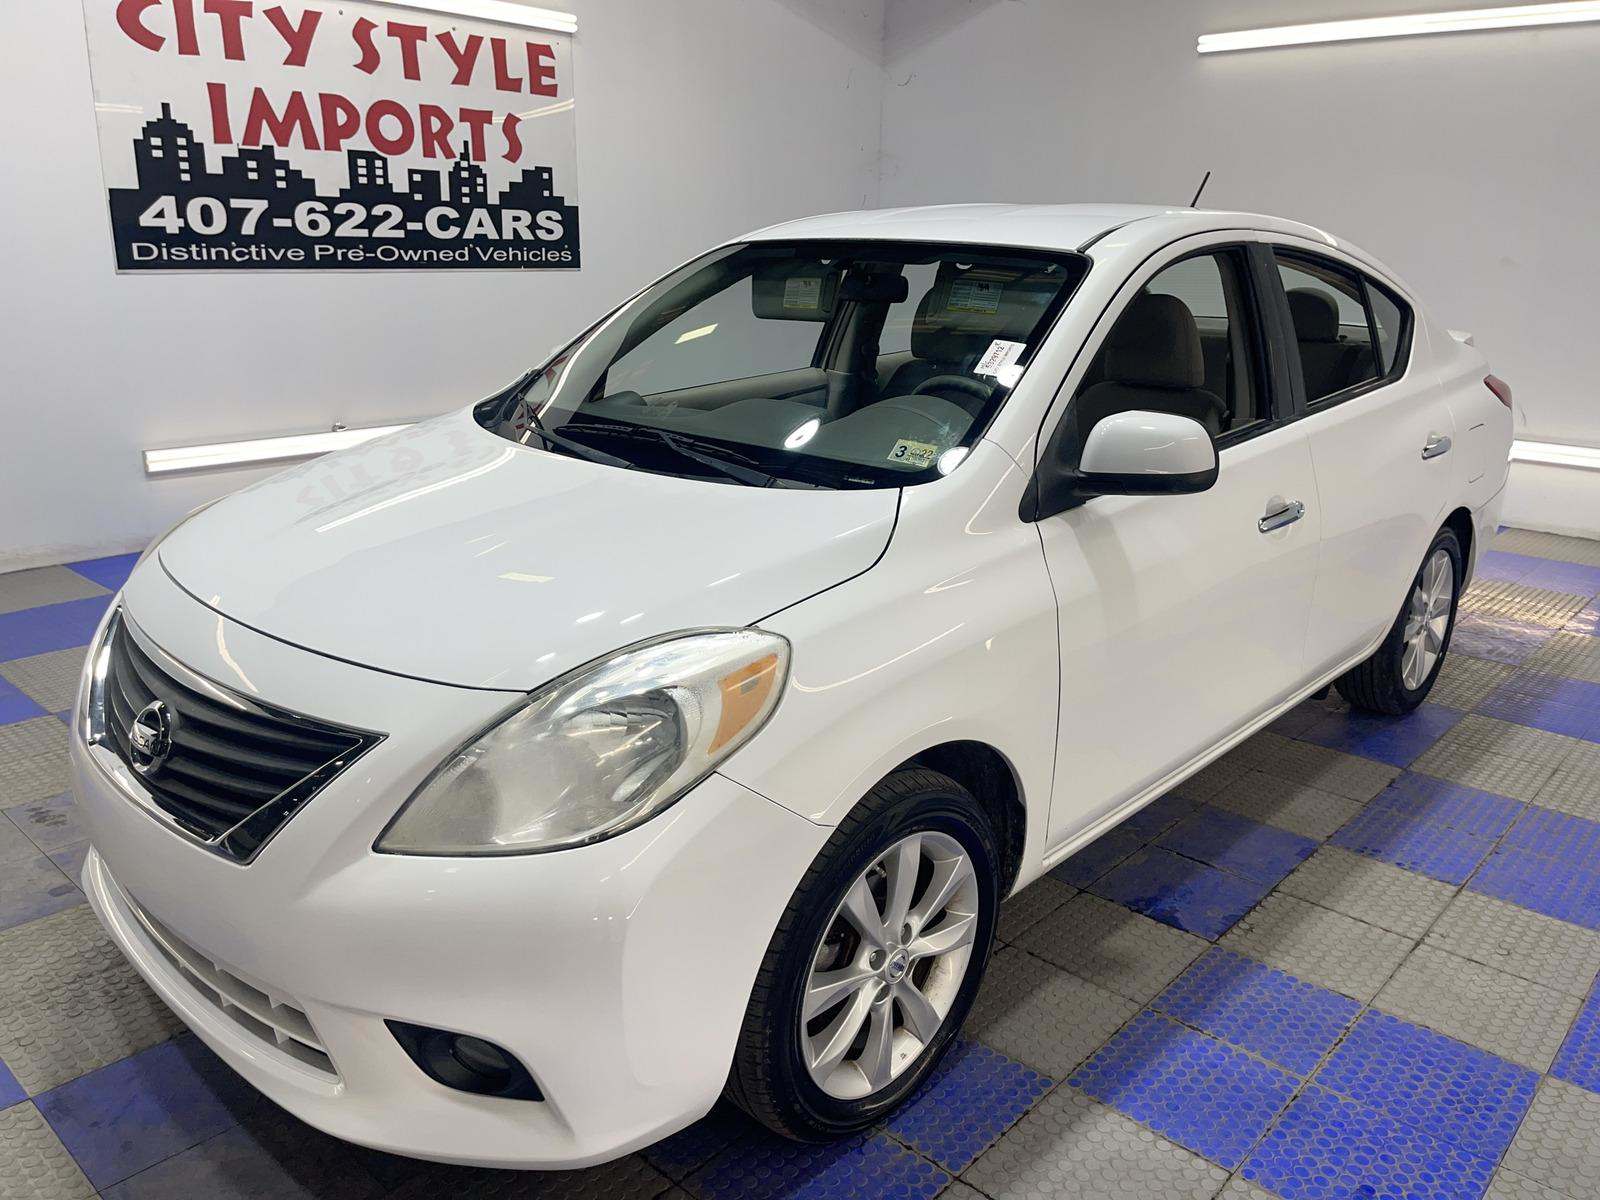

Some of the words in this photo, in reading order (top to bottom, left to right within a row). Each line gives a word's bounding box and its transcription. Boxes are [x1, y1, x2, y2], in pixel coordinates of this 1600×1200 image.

[116, 0, 323, 67] CITY
[352, 17, 558, 98] STYLE
[206, 82, 523, 163] IMPORTS
[138, 195, 564, 241] 407-622-CARS
[131, 242, 305, 262] Distinctive
[313, 244, 469, 262] Pre-Owned
[475, 246, 572, 262] Vehicles
[895, 445, 907, 458] 3
